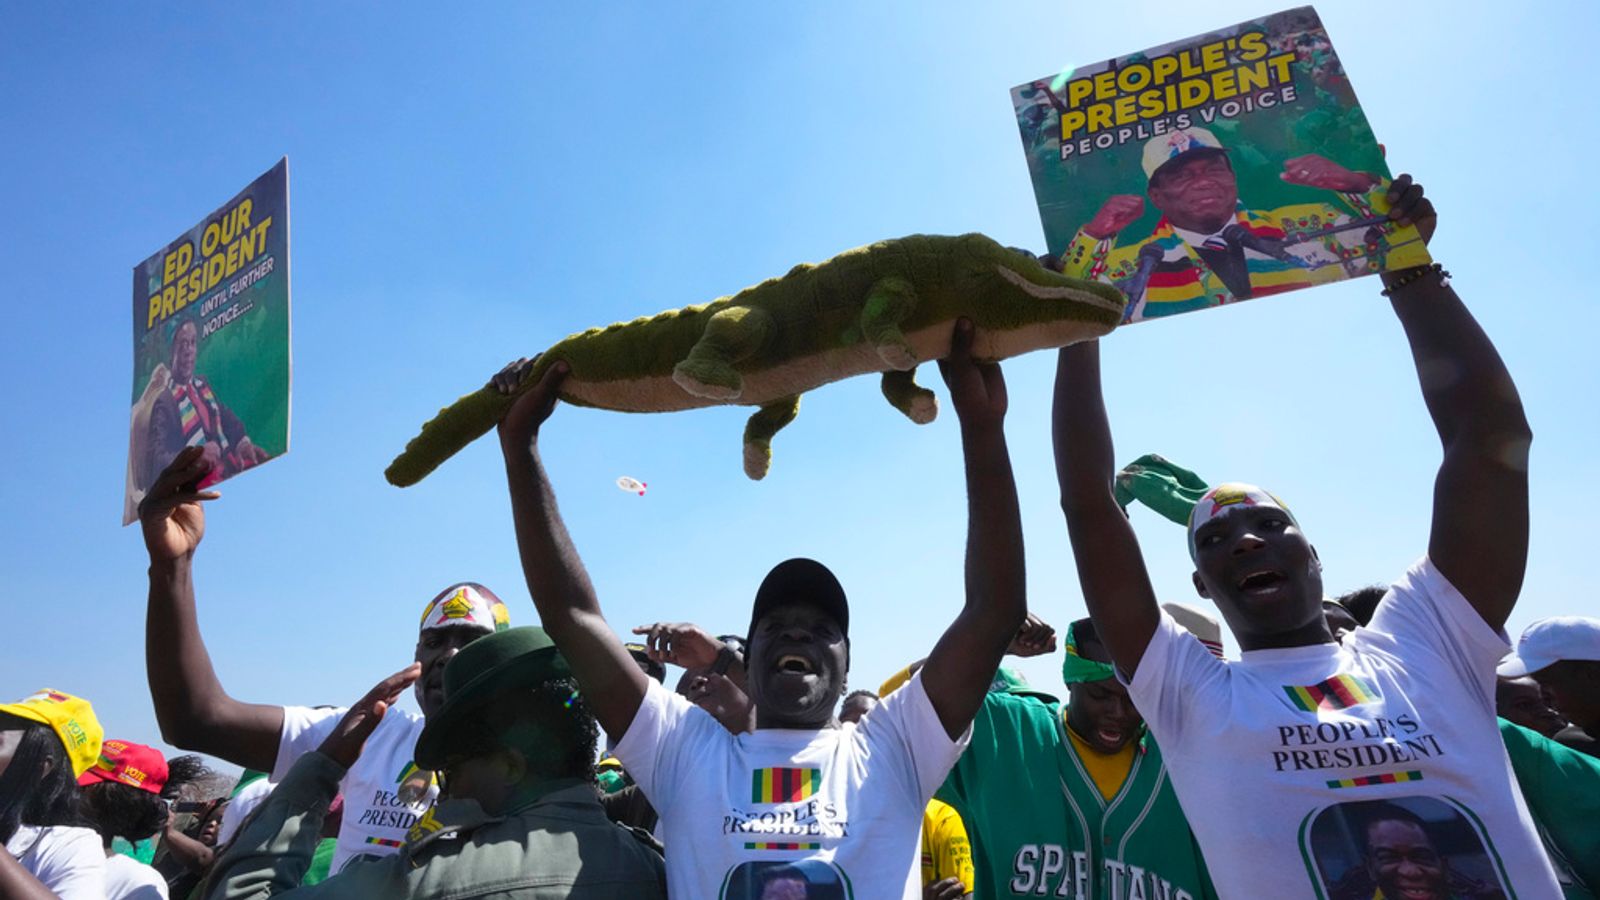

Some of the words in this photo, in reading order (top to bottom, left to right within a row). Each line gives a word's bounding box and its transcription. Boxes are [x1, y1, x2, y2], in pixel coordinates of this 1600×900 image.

[1061, 53, 1296, 141] PRESIDENT
[1069, 32, 1268, 109] PEOPLE'S
[1061, 114, 1191, 160] PEOPLE'S
[1200, 86, 1297, 123] VOICE
[147, 215, 273, 329] PRESIDENT
[163, 243, 193, 286] ED
[201, 198, 253, 257] OUR
[200, 289, 228, 317] UNTIL
[229, 257, 274, 298] FURTHER
[67, 719, 88, 746] VOTE
[1272, 734, 1445, 771] PRESIDENT
[1278, 714, 1419, 746] PEOPLE'S
[124, 765, 148, 782] VOTE
